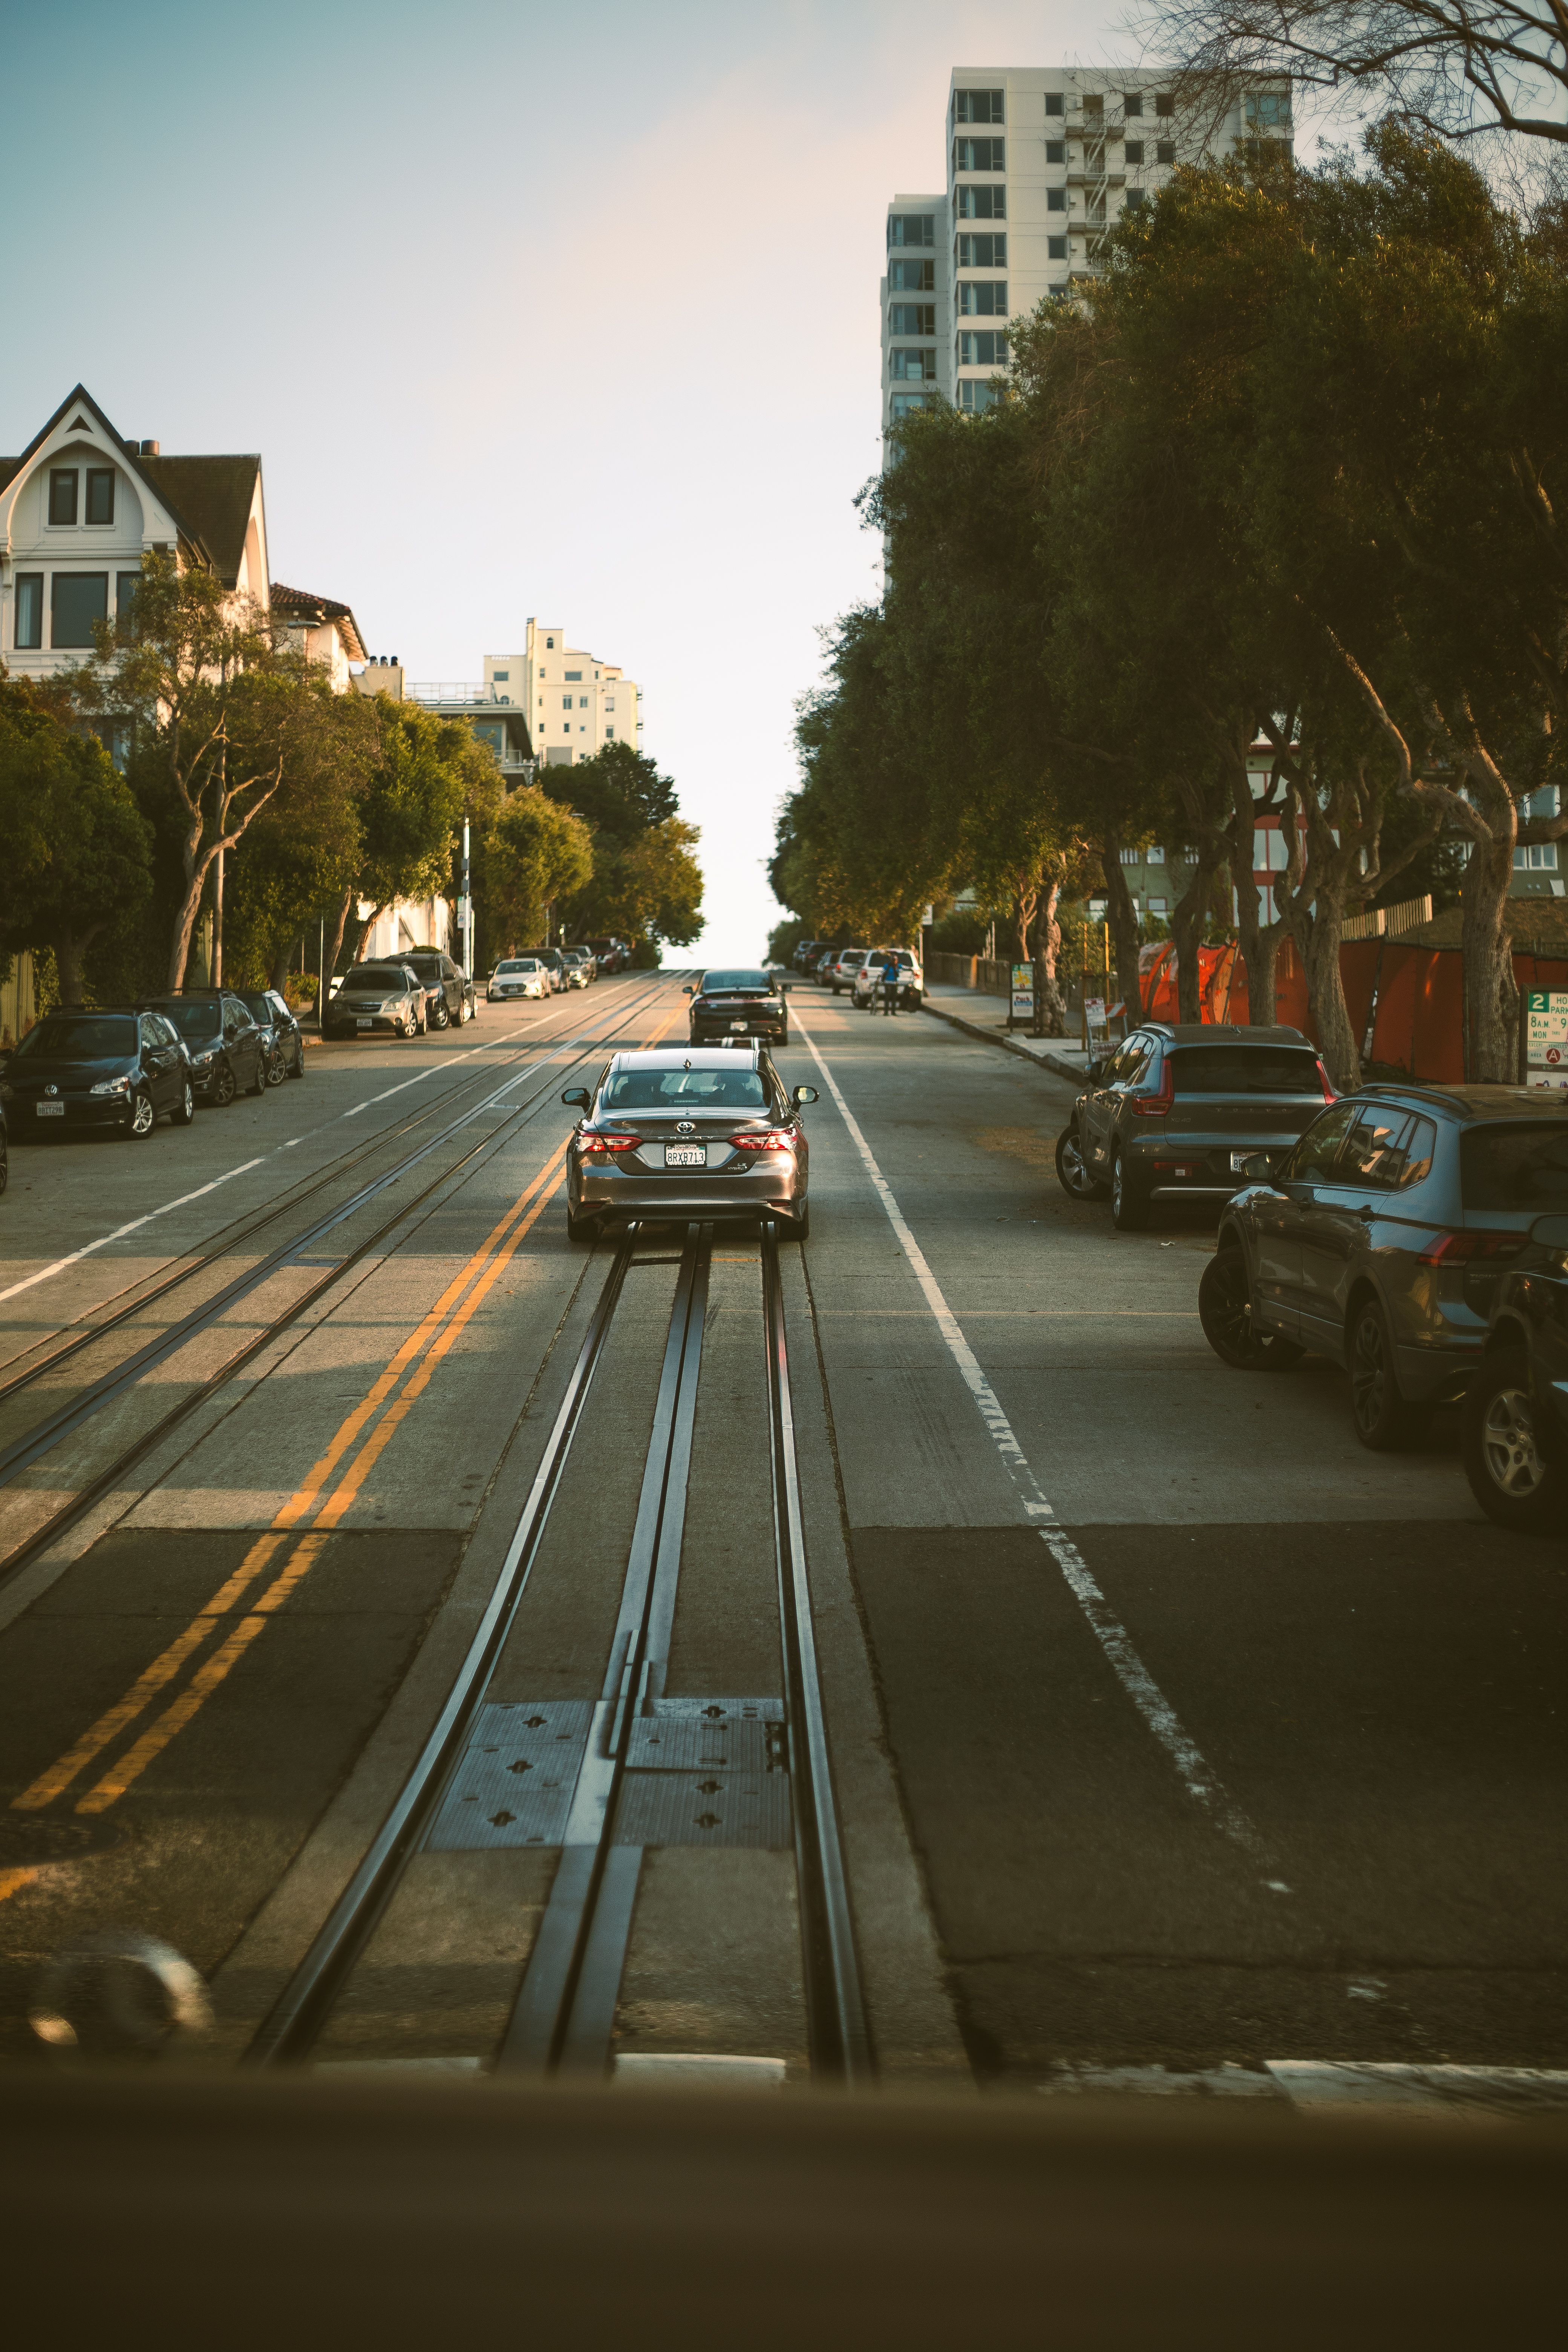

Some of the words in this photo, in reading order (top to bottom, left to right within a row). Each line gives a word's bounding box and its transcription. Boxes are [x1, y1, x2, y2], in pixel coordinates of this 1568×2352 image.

[1532, 994, 1544, 1009] 2
[1548, 1049, 1558, 1061] A
[668, 1152, 704, 1162] 8RXB713
